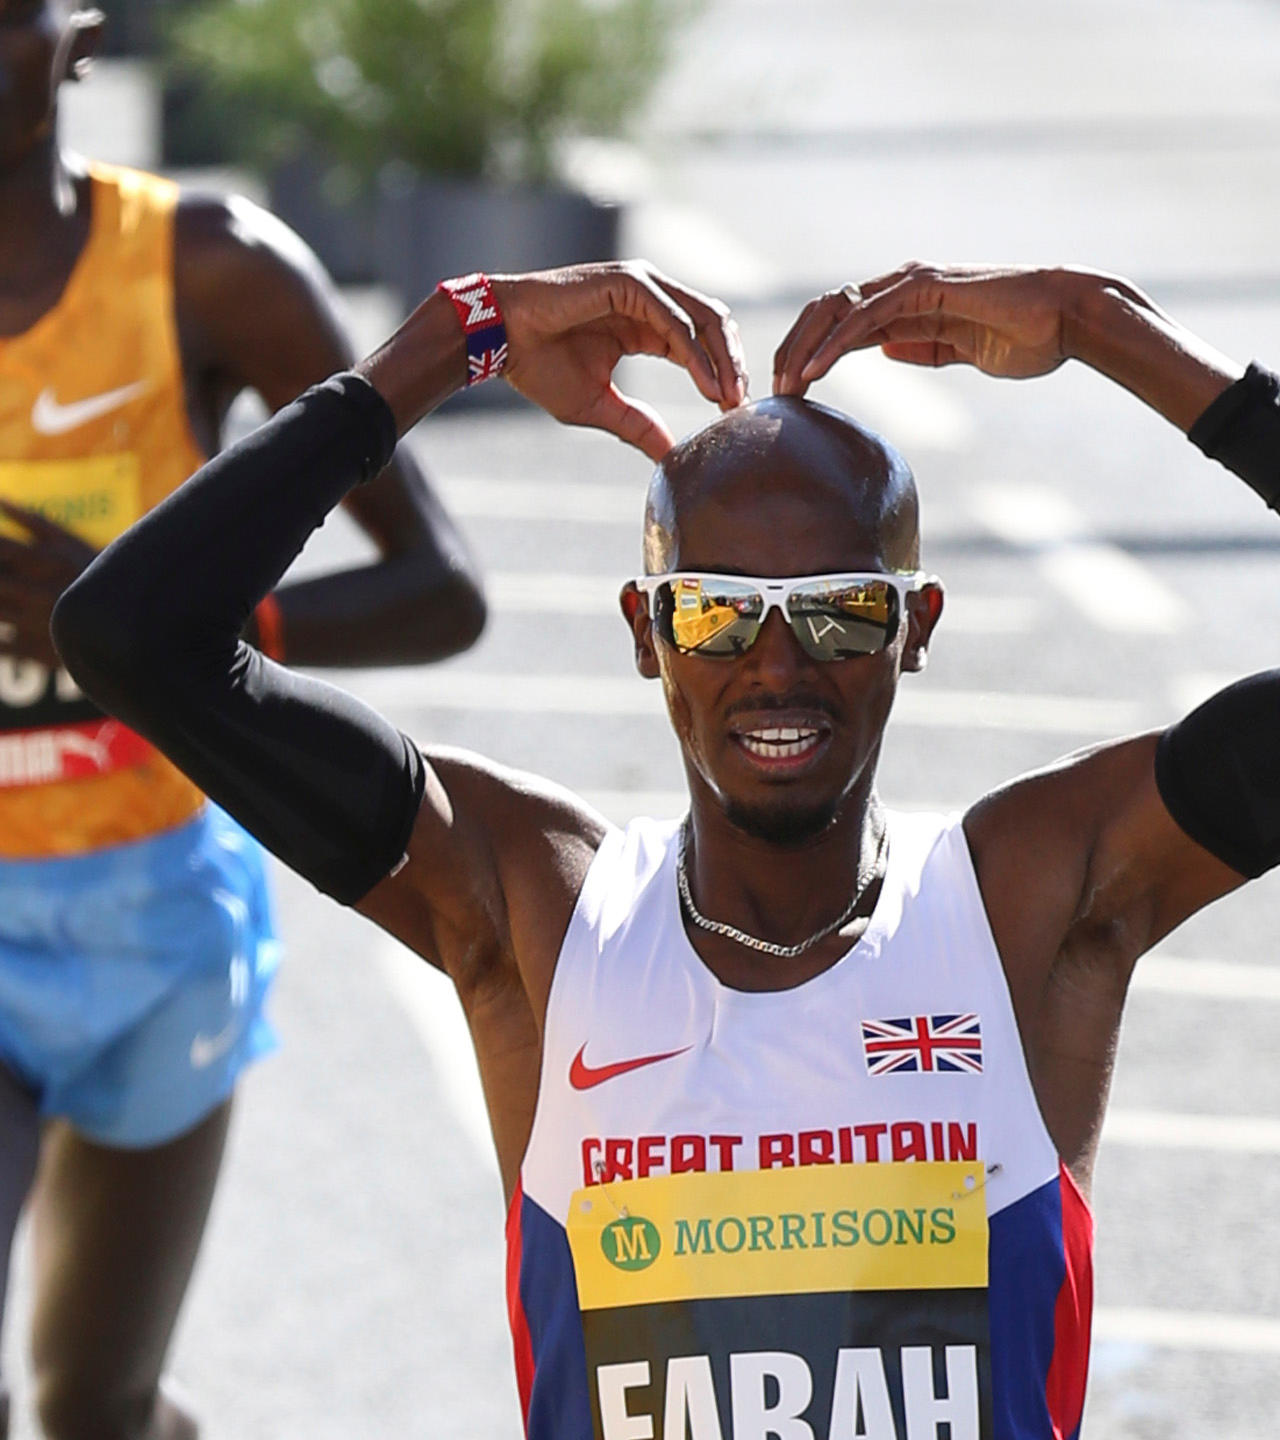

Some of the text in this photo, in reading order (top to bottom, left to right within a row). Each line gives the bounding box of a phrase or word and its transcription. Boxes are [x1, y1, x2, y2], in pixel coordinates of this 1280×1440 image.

[582, 1121, 978, 1188] GREAT BRITAIN
[673, 1208, 957, 1257] MORRISONS
